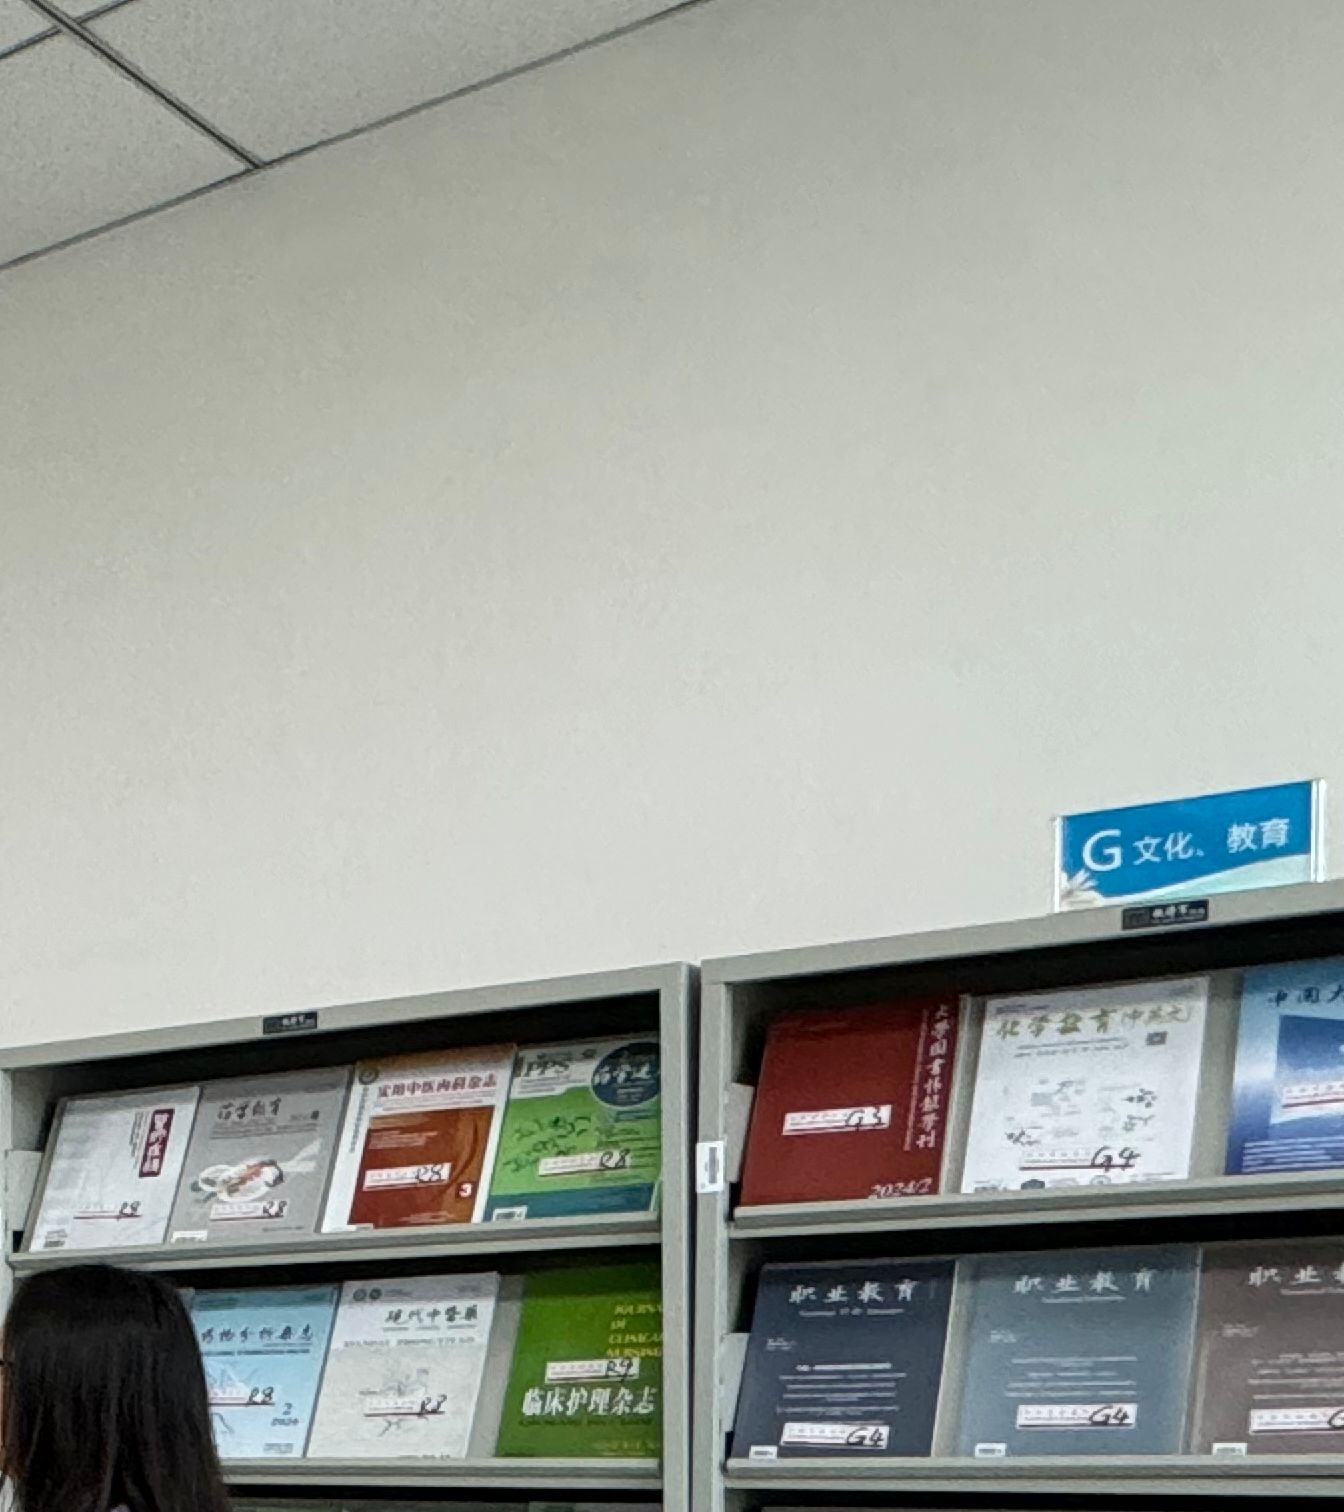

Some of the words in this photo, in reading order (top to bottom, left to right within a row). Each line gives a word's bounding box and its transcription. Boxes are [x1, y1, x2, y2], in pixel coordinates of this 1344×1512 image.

[1082, 829, 1123, 872] G
[1133, 831, 1205, 866] 文化、
[1226, 818, 1290, 854] 教育
[788, 1278, 920, 1304] 职业教育
[1014, 1266, 1157, 1296] 职业教育
[522, 1384, 658, 1417] 临床护理杂志
[1088, 1405, 1130, 1426] G4
[846, 1427, 885, 1448] G4
